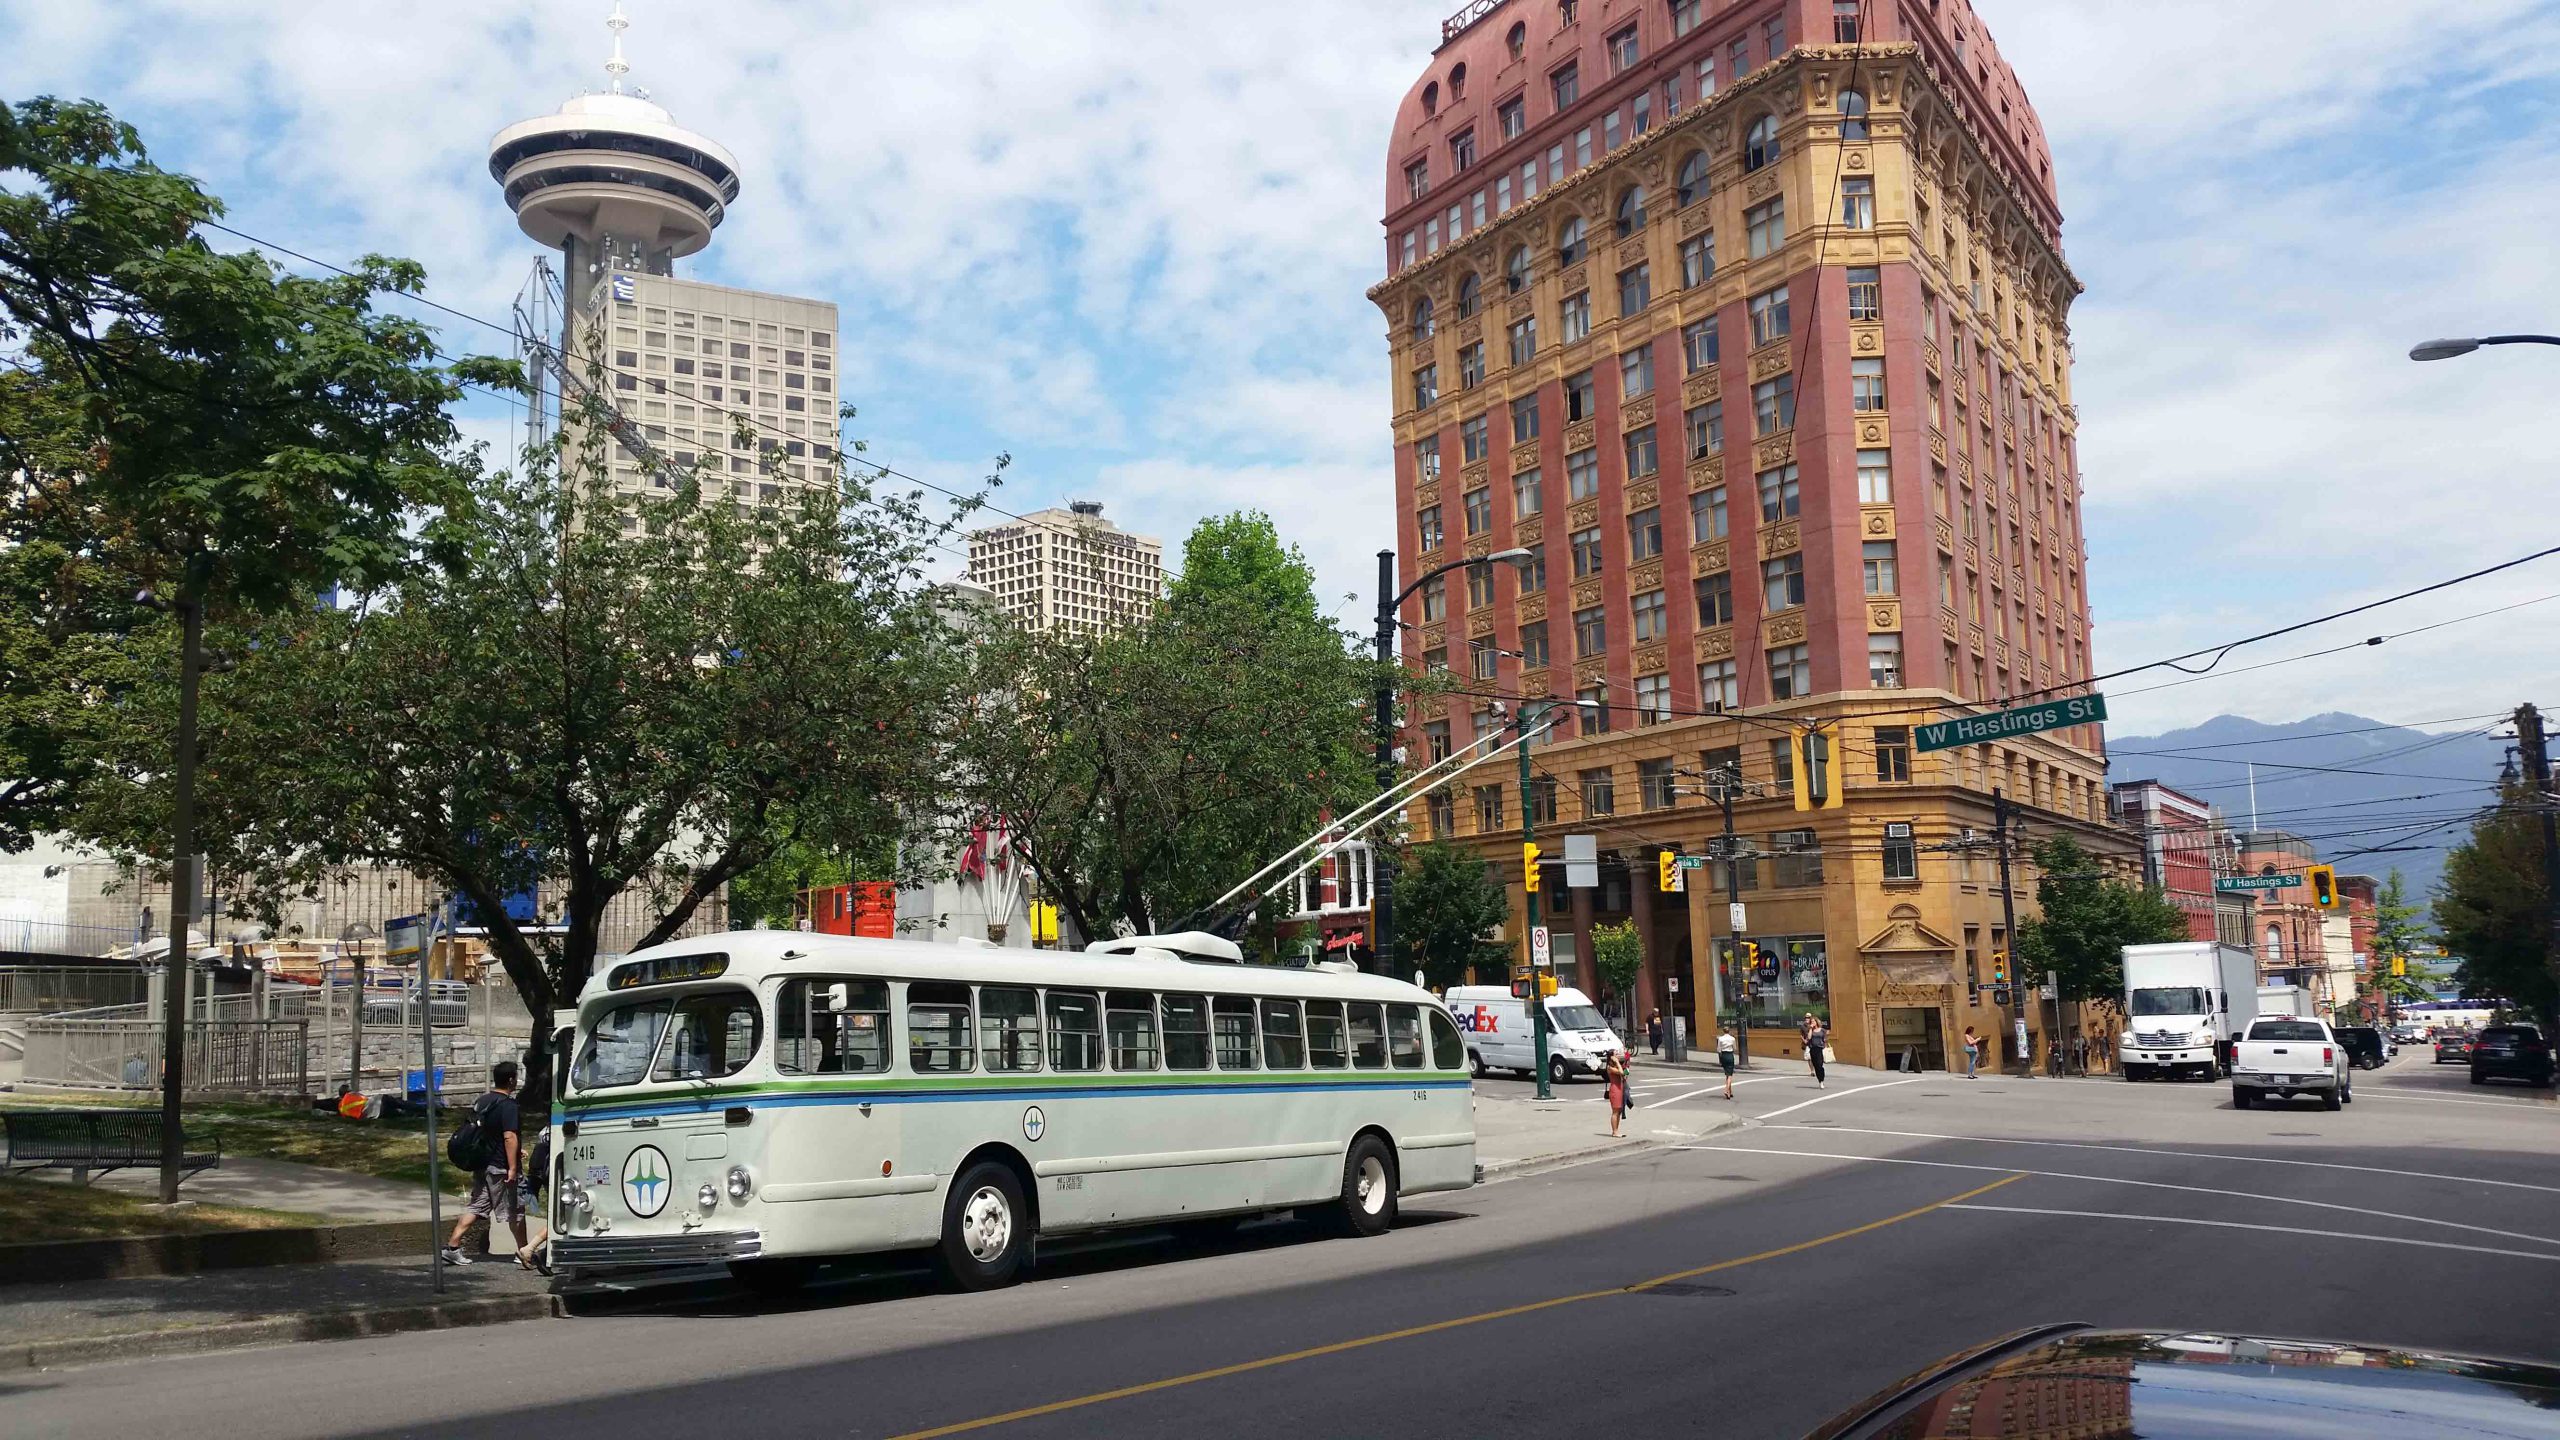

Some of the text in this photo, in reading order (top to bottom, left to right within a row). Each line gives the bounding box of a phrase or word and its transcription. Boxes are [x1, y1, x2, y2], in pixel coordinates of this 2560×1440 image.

[1925, 699, 2095, 745] W Hastings St
[2222, 875, 2297, 888] W Hastings St
[1760, 968, 1776, 976] OPUS
[1450, 1004, 1499, 1033] FedEx
[1581, 1033, 1611, 1044] FedEx
[1413, 1090, 1427, 1100] 2416
[573, 1145, 595, 1160] 2416
